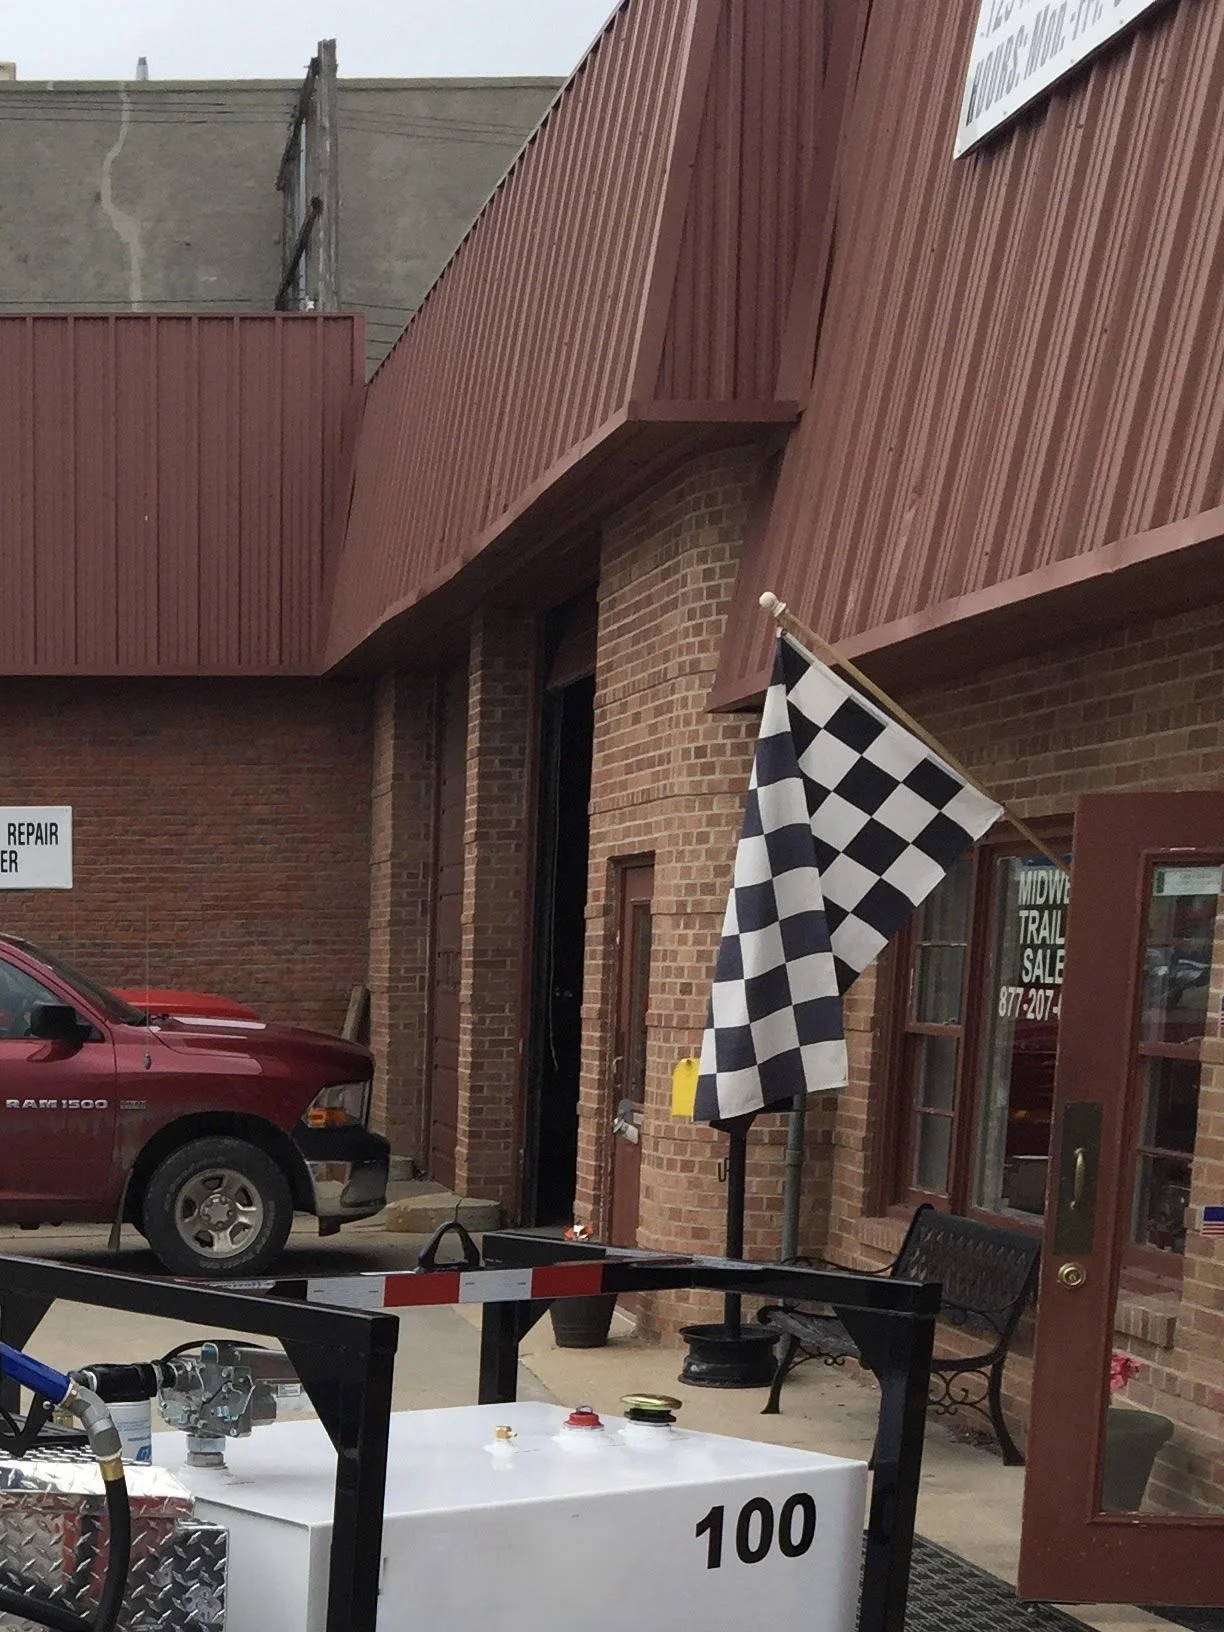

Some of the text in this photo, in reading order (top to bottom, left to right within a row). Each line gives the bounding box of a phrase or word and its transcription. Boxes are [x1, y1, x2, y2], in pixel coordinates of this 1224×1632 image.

[7, 822, 59, 846] REPAIR
[1018, 909, 1066, 945] TRAIL
[1022, 948, 1064, 984] SALE
[5, 1099, 58, 1109] RAM
[61, 1099, 109, 1109] 1500
[695, 1492, 817, 1570] 100
